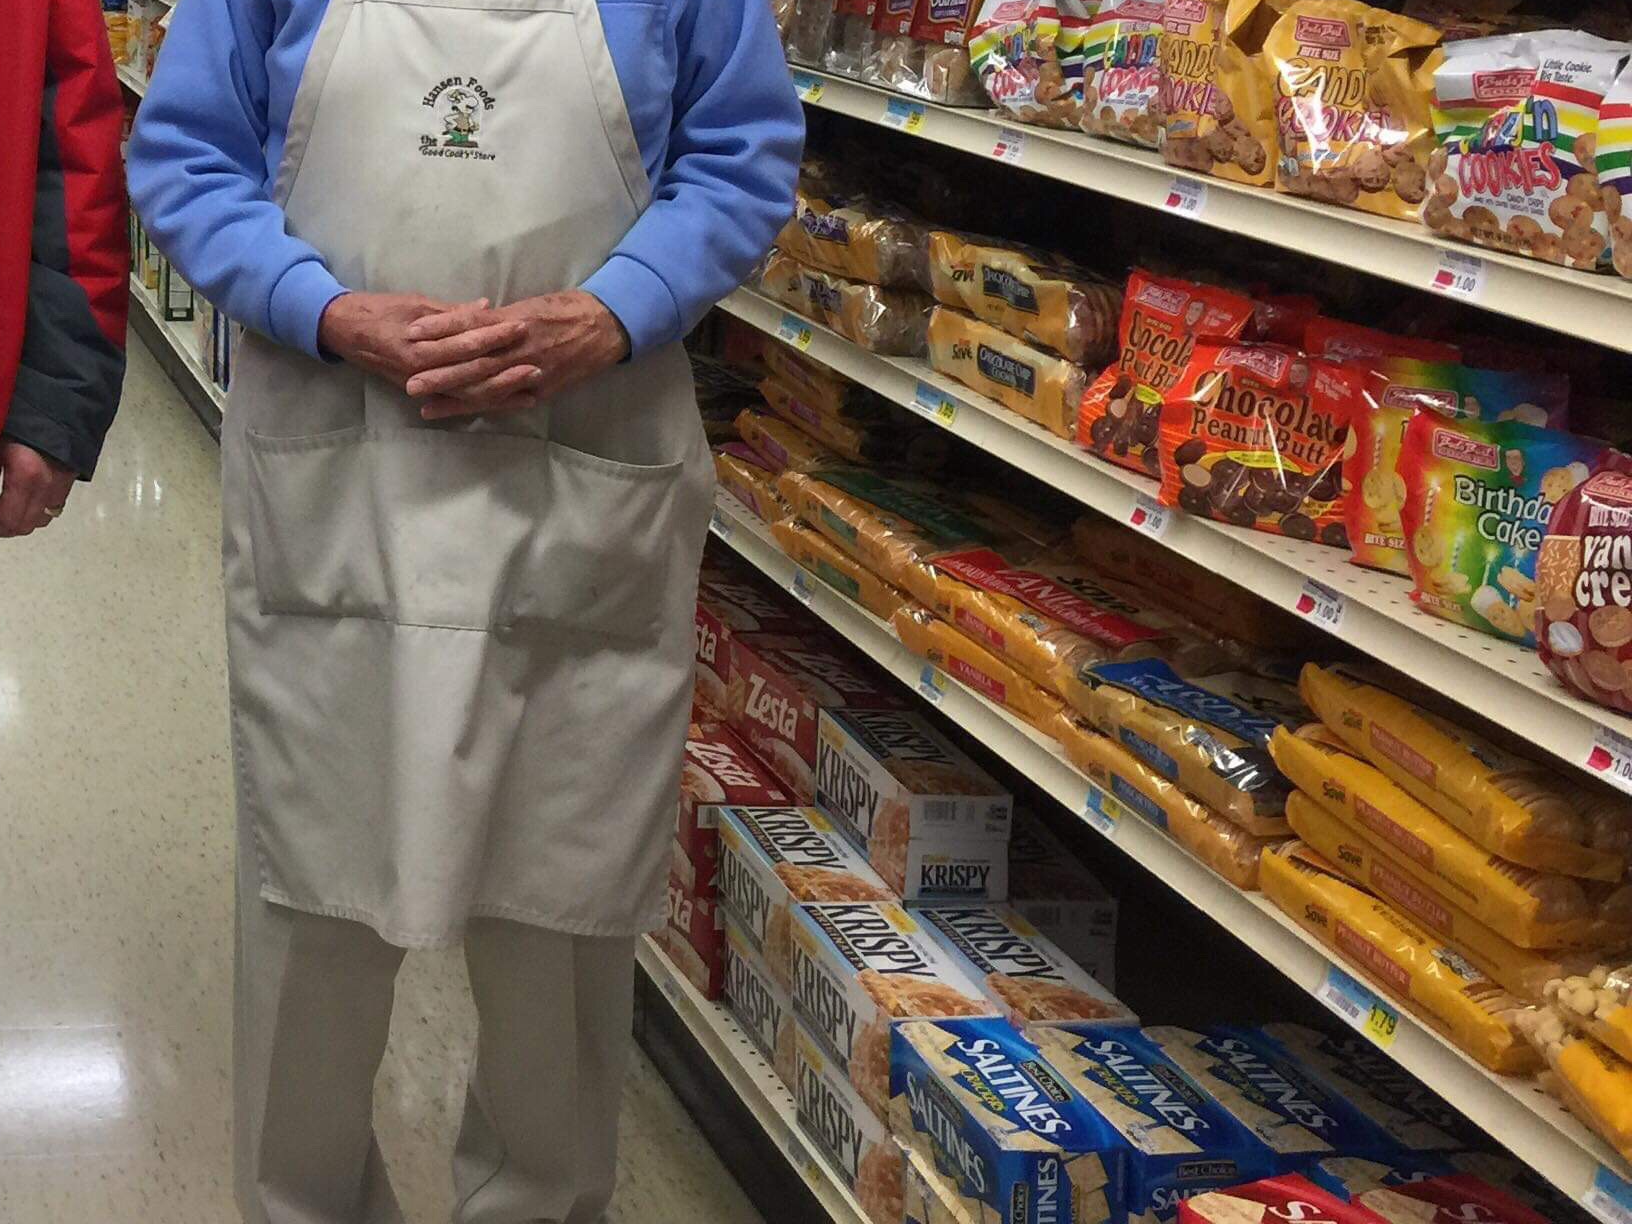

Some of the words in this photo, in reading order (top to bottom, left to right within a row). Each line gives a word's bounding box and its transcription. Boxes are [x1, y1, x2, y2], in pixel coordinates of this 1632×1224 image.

[1300, 47, 1320, 58] BITE
[422, 77, 462, 108] Hansen
[466, 77, 496, 111] Foods
[473, 151, 496, 161] Store
[1458, 142, 1562, 197] COOKIES
[1454, 274, 1477, 293] 1.00
[1191, 407, 1269, 442] Peanut
[1277, 429, 1327, 465] Butt
[1455, 476, 1552, 525] Birthda
[1477, 512, 1542, 552] Cake
[1575, 570, 1632, 607] cre
[744, 672, 799, 741] Zesta
[685, 740, 761, 788] Zesta
[819, 739, 880, 838] KRISPY
[752, 807, 848, 870] KRISPY
[921, 863, 991, 887] KRISPY
[817, 903, 937, 979] KRISPY
[936, 907, 1066, 980] KRISPY
[1305, 904, 1329, 927] Save
[724, 948, 782, 1064] KRISPY
[791, 944, 857, 1063] KRISPY
[1369, 1003, 1397, 1036] 1.79
[795, 1050, 864, 1177] KRISPY
[956, 1038, 1072, 1135] SALTINES
[1084, 1039, 1210, 1135] SALTINES
[1205, 1036, 1338, 1131] SALTINES
[905, 1070, 986, 1195] SALTINES
[1038, 1158, 1059, 1224] TINES
